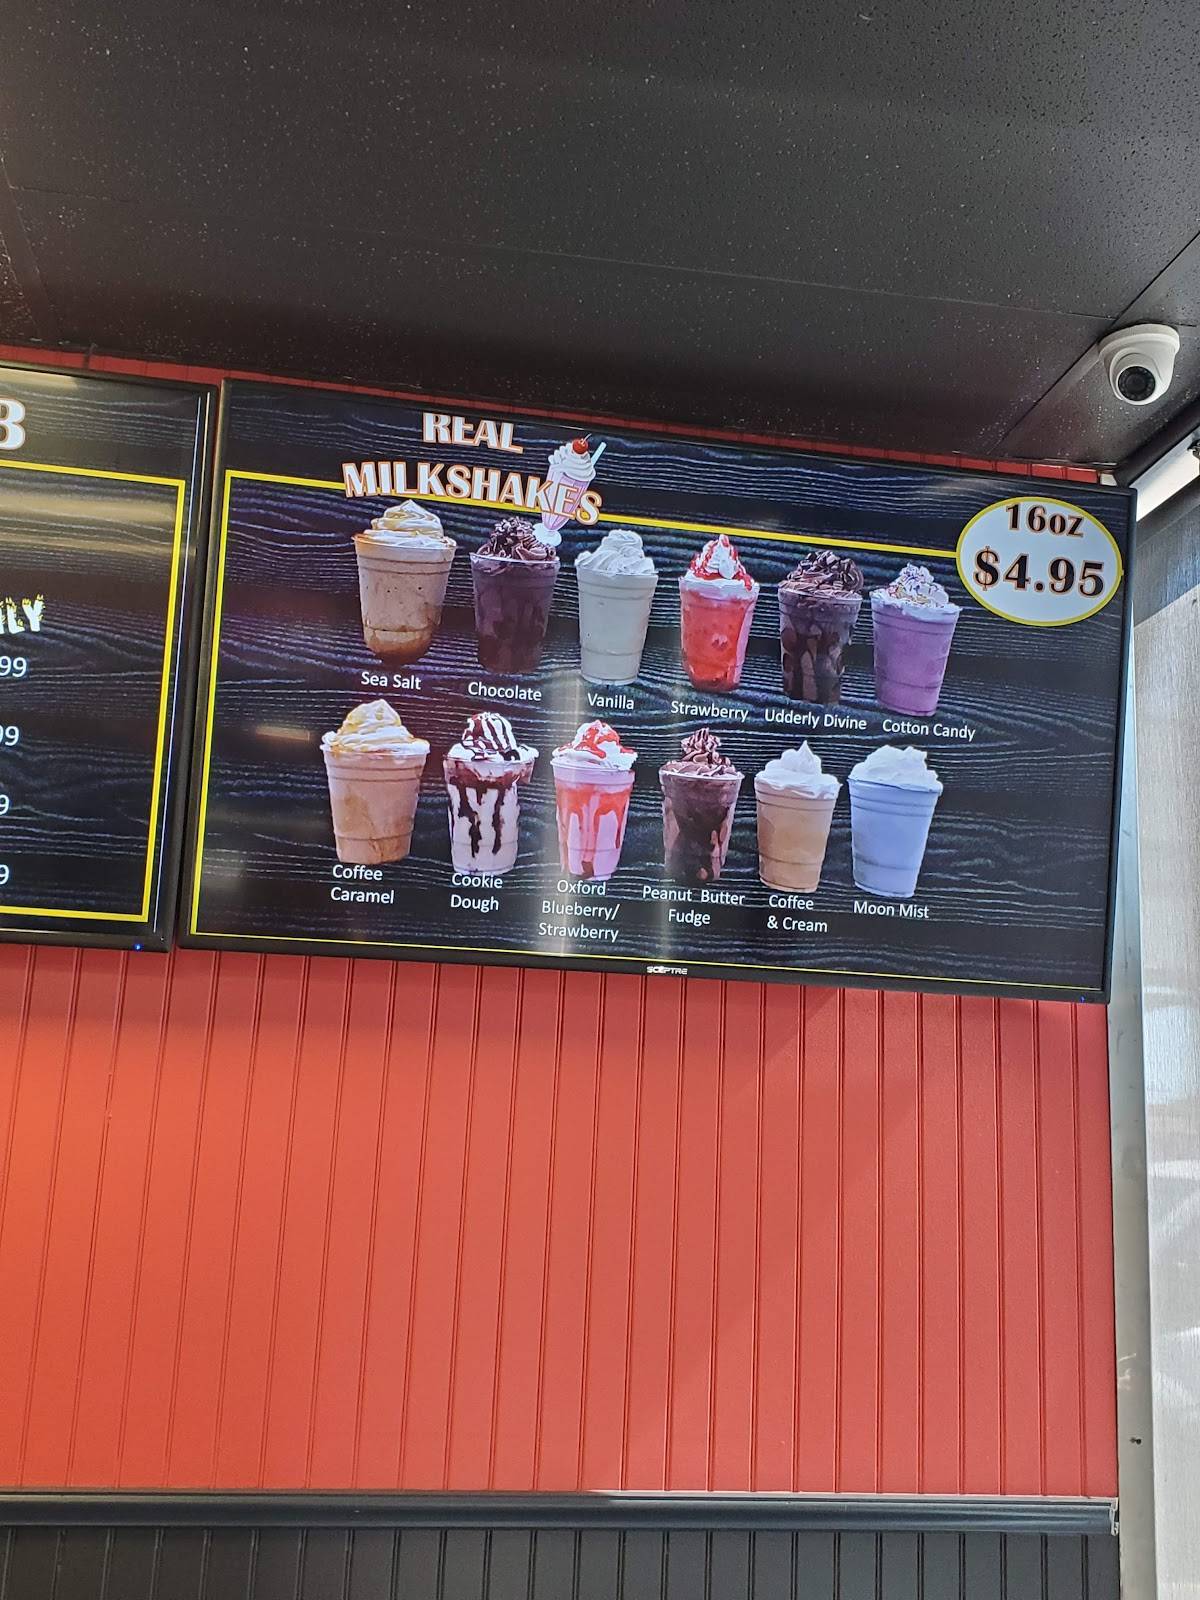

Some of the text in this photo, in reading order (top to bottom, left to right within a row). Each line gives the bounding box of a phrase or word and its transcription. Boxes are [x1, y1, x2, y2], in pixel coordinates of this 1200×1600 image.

[423, 412, 524, 454] REAL
[342, 461, 603, 526] MILKSHAKES
[1005, 503, 1085, 538] 16oz
[973, 546, 1105, 597] $4.95
[361, 671, 422, 691] Sea Salt
[467, 681, 542, 702] Chocolate
[587, 692, 634, 710] Vanilla
[670, 700, 749, 722] Strawberry
[764, 708, 868, 730] Udderly Divine
[882, 718, 976, 741] Cotton Candy
[332, 864, 383, 882] Coffee
[451, 872, 503, 889] Cookie
[330, 886, 395, 904] Caramel
[557, 879, 606, 896] Oxford
[642, 885, 745, 906] Peanut Butter
[450, 894, 500, 913] Dough
[541, 900, 621, 921] Blueberry/
[768, 894, 814, 910] Coffee
[853, 899, 929, 919] Moon Mist
[668, 909, 711, 927] Fudge
[766, 915, 828, 933] & Cream
[538, 922, 619, 943] Strawberry
[646, 965, 688, 975] SCEPTRE
